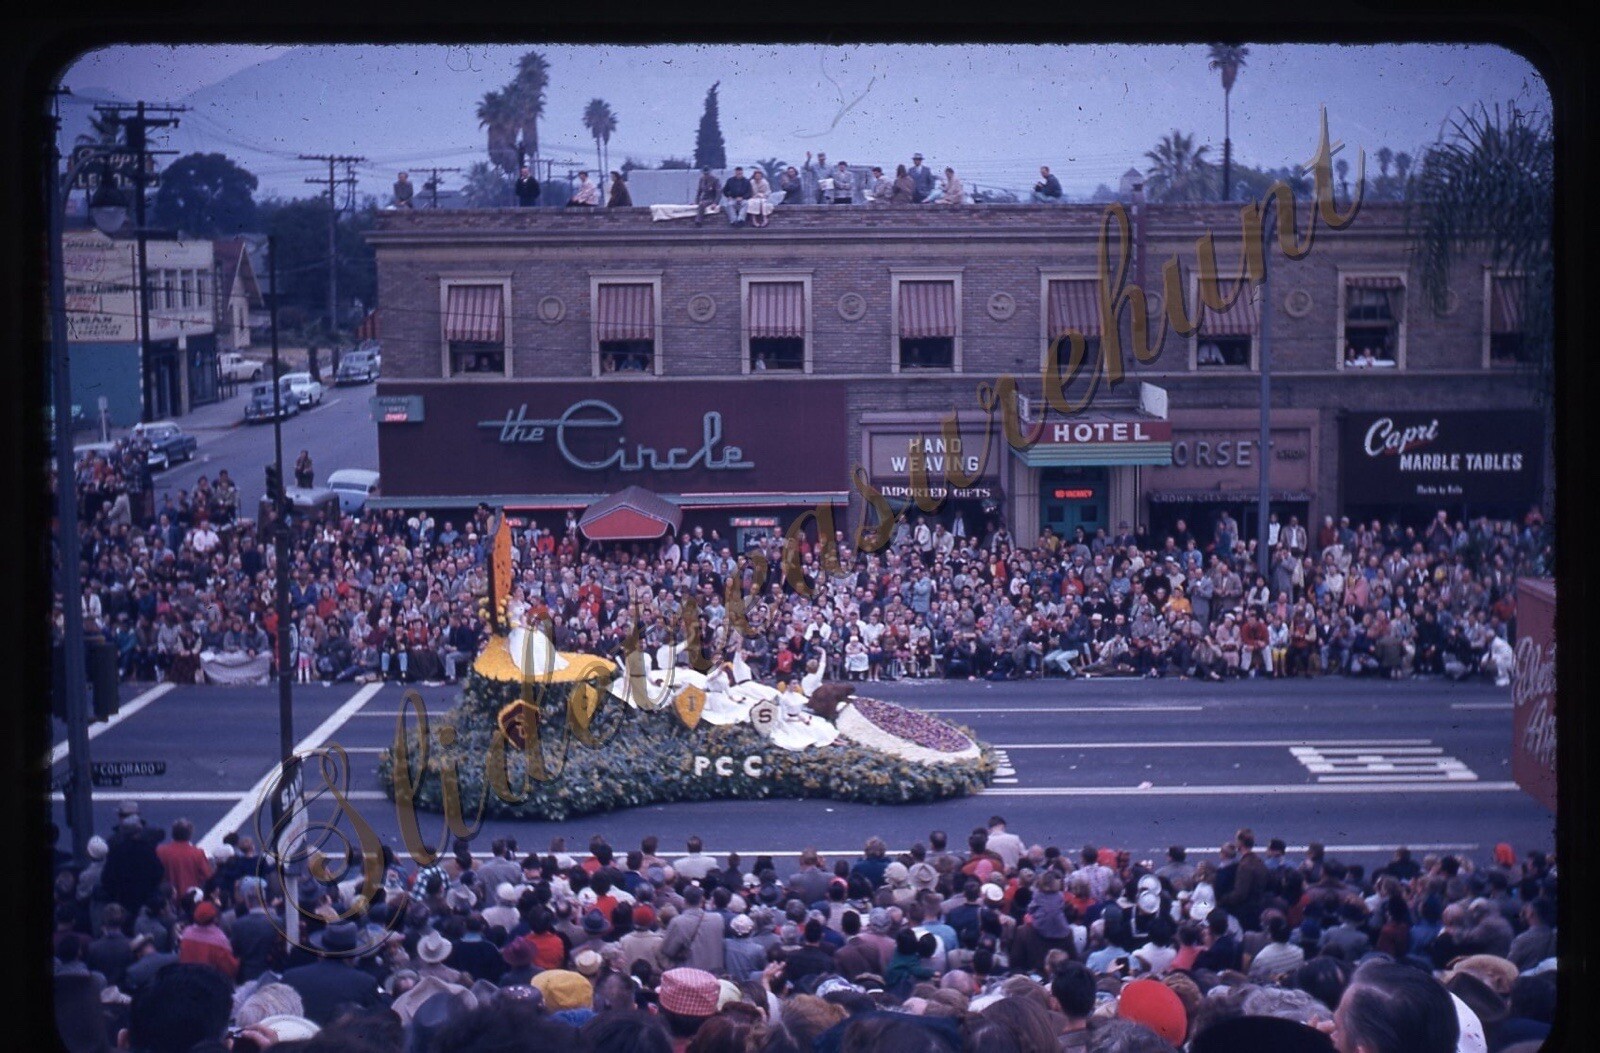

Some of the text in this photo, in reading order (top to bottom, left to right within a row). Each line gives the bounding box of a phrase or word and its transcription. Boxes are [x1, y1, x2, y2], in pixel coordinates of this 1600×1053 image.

[478, 399, 755, 471] the Circle
[1054, 423, 1150, 442] HOTEL
[1363, 417, 1439, 457] Capri
[909, 438, 962, 453] HAND
[891, 455, 979, 472] WEAVING
[1400, 453, 1523, 472] MARBLE TABLES
[881, 486, 991, 499] IMPORTED GIFTS
[758, 708, 773, 724] S
[100, 763, 155, 775] COLORADO
